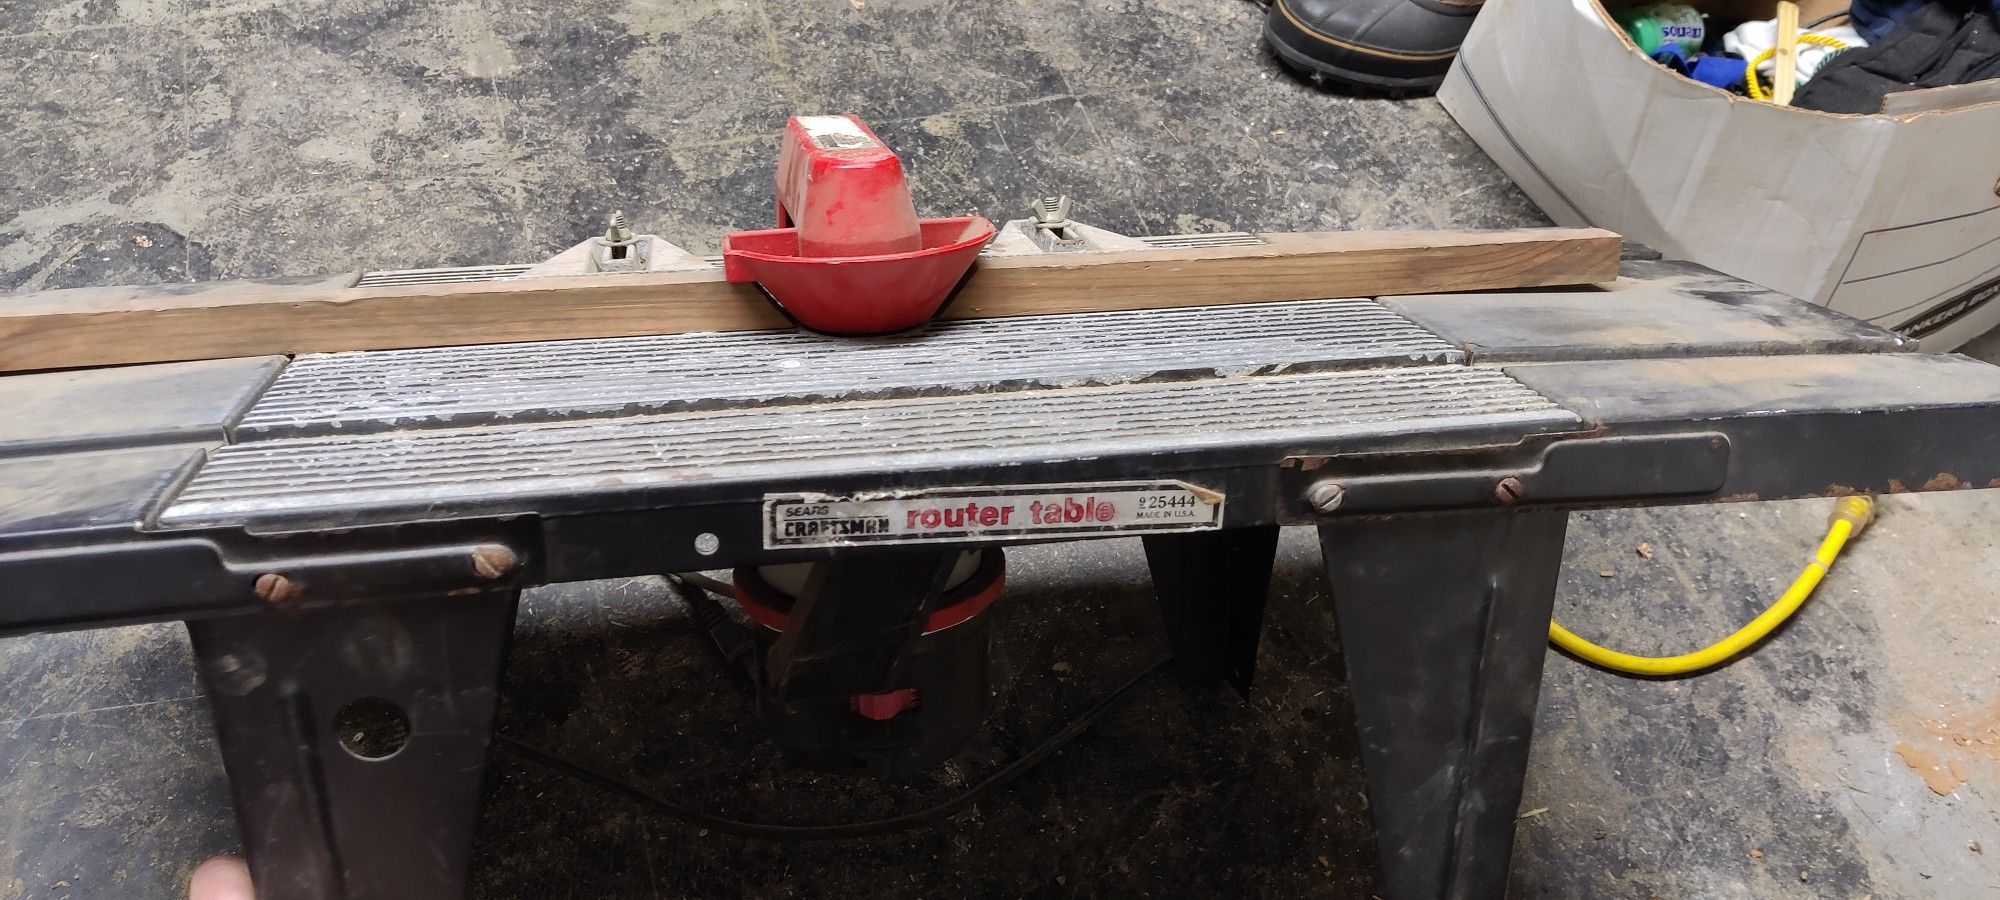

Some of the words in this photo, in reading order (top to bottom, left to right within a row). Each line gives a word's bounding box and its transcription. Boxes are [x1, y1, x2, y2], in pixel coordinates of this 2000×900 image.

[785, 505, 830, 518] SEARS
[906, 502, 1014, 529] router
[1029, 496, 1115, 524] table
[1136, 511, 1160, 519] MADE
[1163, 510, 1171, 518] IN
[784, 518, 890, 537] CRAFTSMAN
